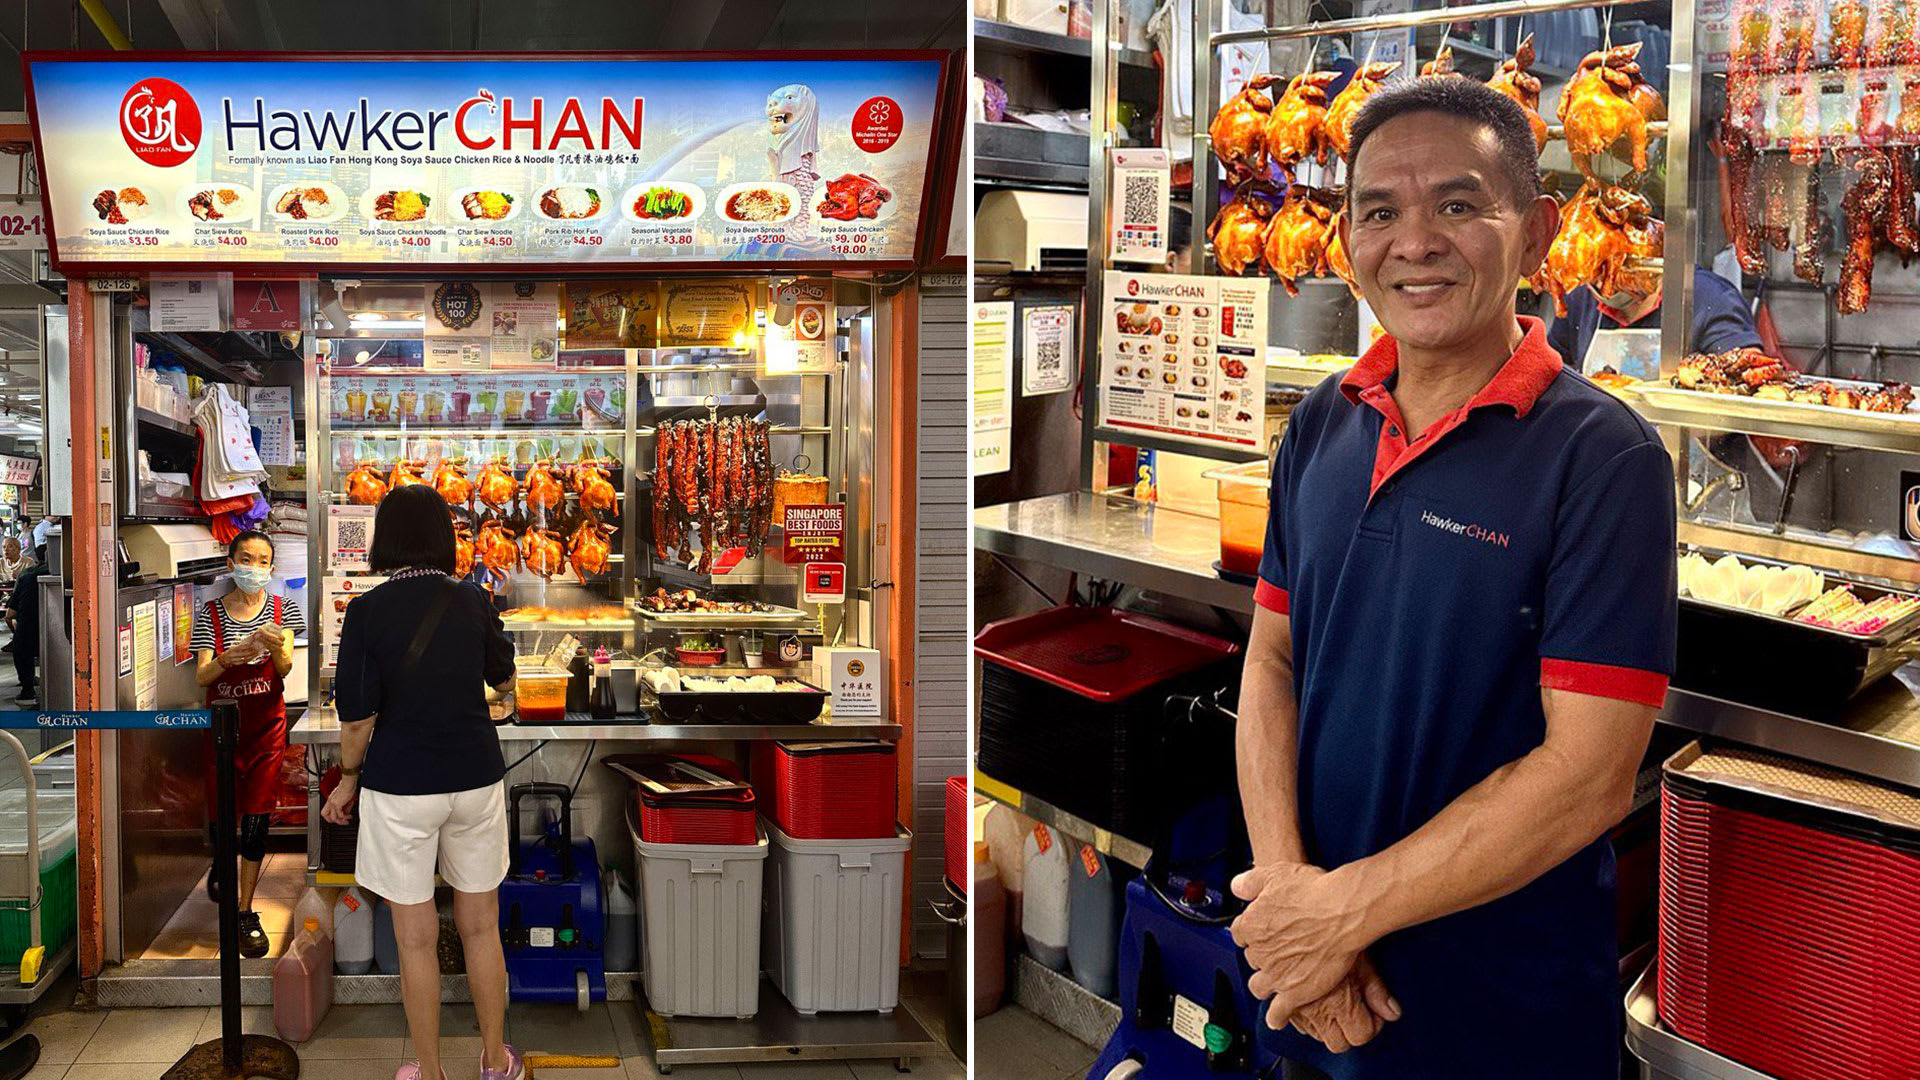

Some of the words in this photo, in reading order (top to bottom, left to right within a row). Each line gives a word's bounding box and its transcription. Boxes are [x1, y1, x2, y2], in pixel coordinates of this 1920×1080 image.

[228, 155, 264, 166] Formally
[266, 155, 294, 164] known
[308, 155, 327, 164] Liao
[330, 155, 347, 164] Fan
[348, 155, 372, 166] Hong
[374, 155, 398, 166] Kong
[400, 155, 422, 166] Soya
[424, 155, 452, 164] Sauce
[454, 155, 490, 164] Chicken
[492, 155, 512, 164] Rice
[514, 155, 521, 164] &
[523, 155, 555, 164] Noodle
[89, 228, 106, 236] Soya
[662, 227, 692, 235] Vegetable
[128, 236, 158, 246] $3.50
[217, 236, 247, 246] $4.00
[309, 236, 338, 246] $4.00
[401, 236, 430, 246] $4.00
[483, 236, 512, 246] $4.50
[573, 236, 602, 245] $4.50
[663, 235, 692, 244] $3.80
[756, 234, 785, 244] $2.00
[830, 245, 866, 254] $18.00
[97, 280, 130, 289] 02-126
[930, 275, 962, 285] 02-127
[1142, 283, 1205, 298] HawkerCHAN
[250, 281, 283, 313] A
[446, 301, 467, 309] HOT
[448, 309, 465, 318] 100
[787, 508, 842, 519] SINGAPORE
[788, 520, 810, 529] BEST
[812, 520, 840, 529] FOODS
[1420, 510, 1510, 548] HawkerCHAN
[233, 680, 272, 697] CHAN
[53, 717, 88, 726] CHAN
[172, 716, 208, 725] CHAN
